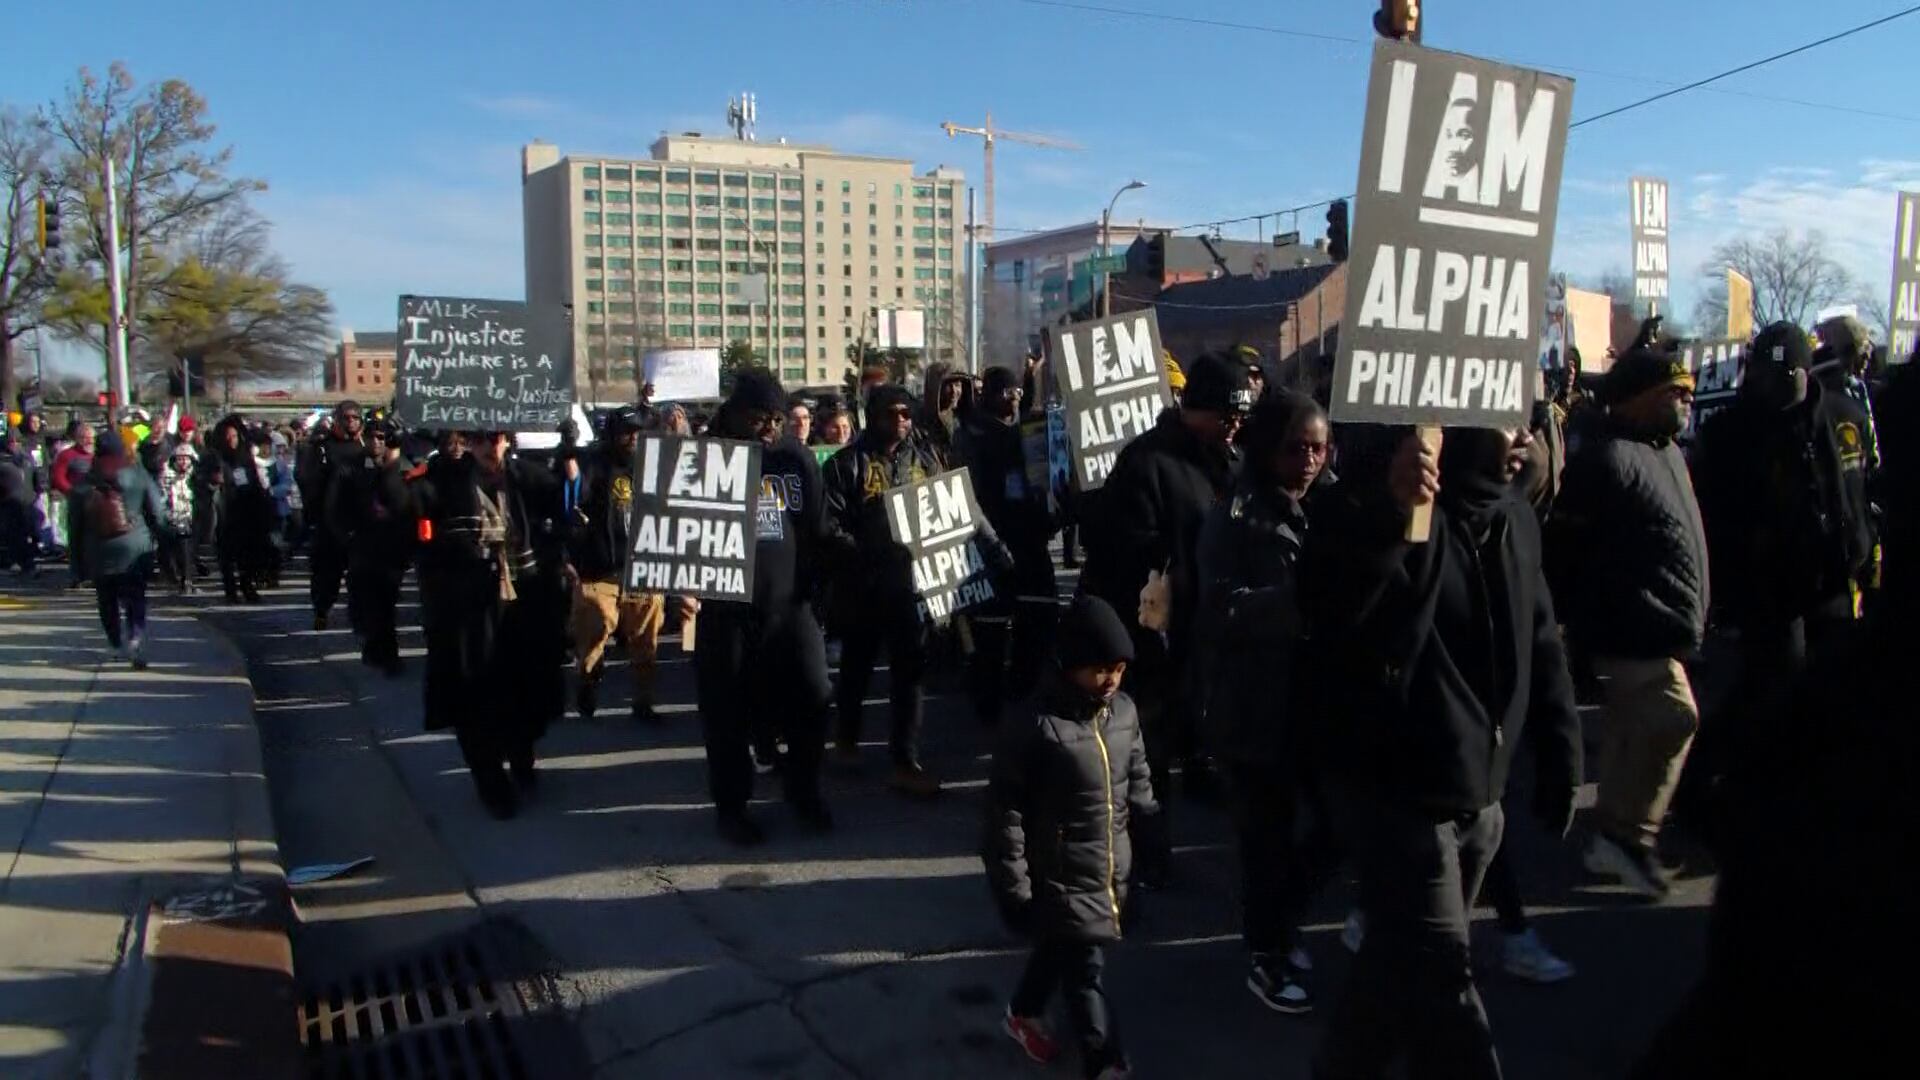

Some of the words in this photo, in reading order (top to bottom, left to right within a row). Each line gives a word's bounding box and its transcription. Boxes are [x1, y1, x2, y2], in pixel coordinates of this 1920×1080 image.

[1379, 60, 1417, 193] I
[1423, 72, 1556, 212] AM
[1632, 180, 1641, 225] I
[1643, 182, 1667, 228] AM
[1358, 244, 1529, 340] ALPHA
[536, 354, 553, 370] A
[1061, 333, 1084, 391] I
[1092, 318, 1156, 385] AM
[1347, 350, 1416, 406] PHI
[1418, 355, 1522, 413] ALPHA
[642, 438, 660, 496] I
[667, 440, 749, 501] AM
[892, 493, 912, 543] I
[917, 474, 972, 538] AM
[634, 515, 745, 559] ALPHA
[631, 561, 672, 589] PHI
[673, 564, 745, 593] ALPHA
[912, 541, 985, 591] ALPHA
[916, 597, 946, 623] PHI
[947, 578, 995, 613] ALPHA
